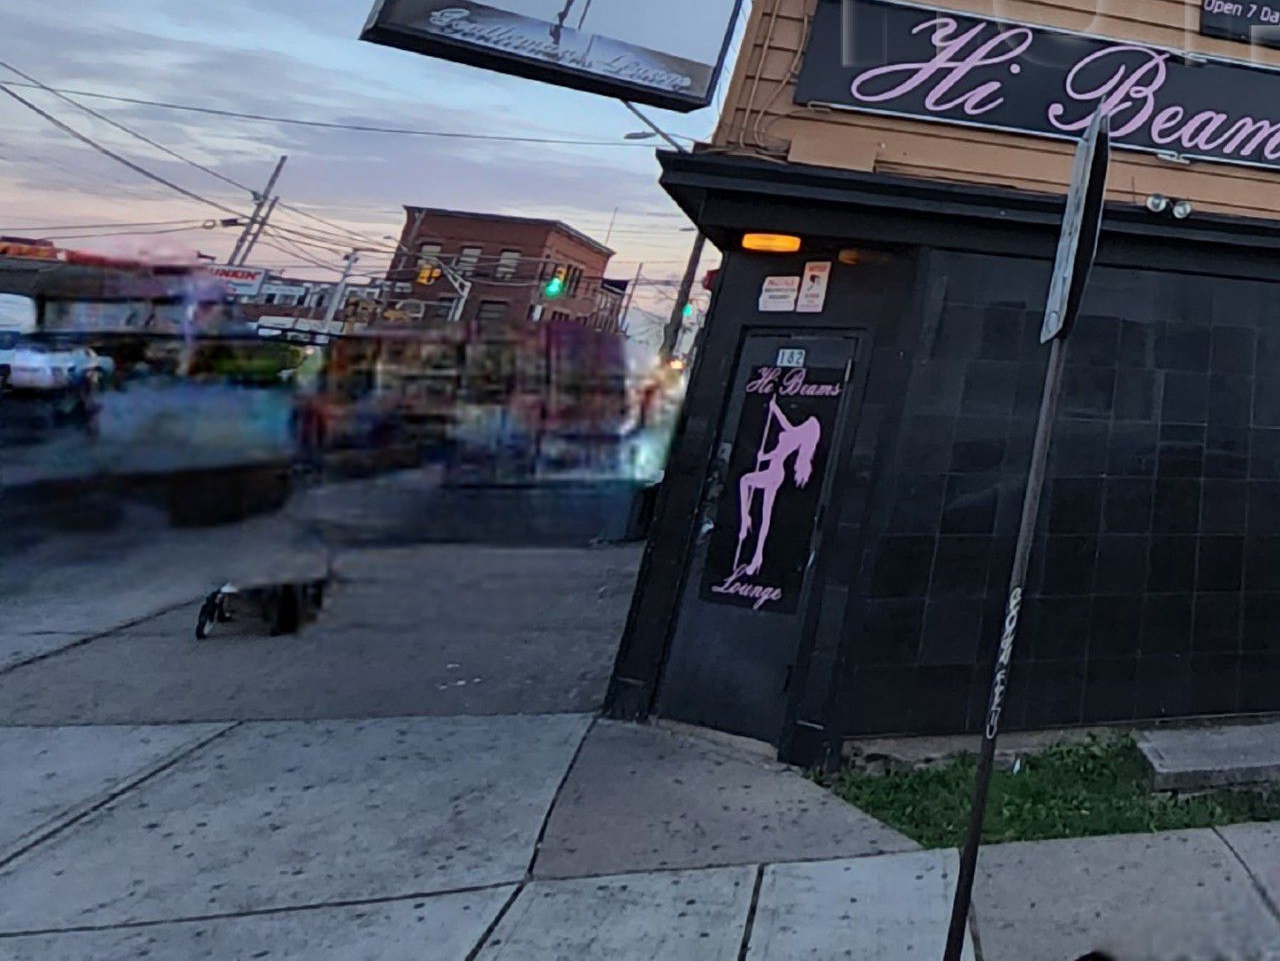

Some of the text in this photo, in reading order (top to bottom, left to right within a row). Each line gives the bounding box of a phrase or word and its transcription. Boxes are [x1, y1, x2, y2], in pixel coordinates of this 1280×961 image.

[1247, 4, 1257, 18] 7
[851, 17, 1033, 115] Hi
[745, 367, 840, 396] Hi Beams
[711, 563, 782, 610] Lounge
